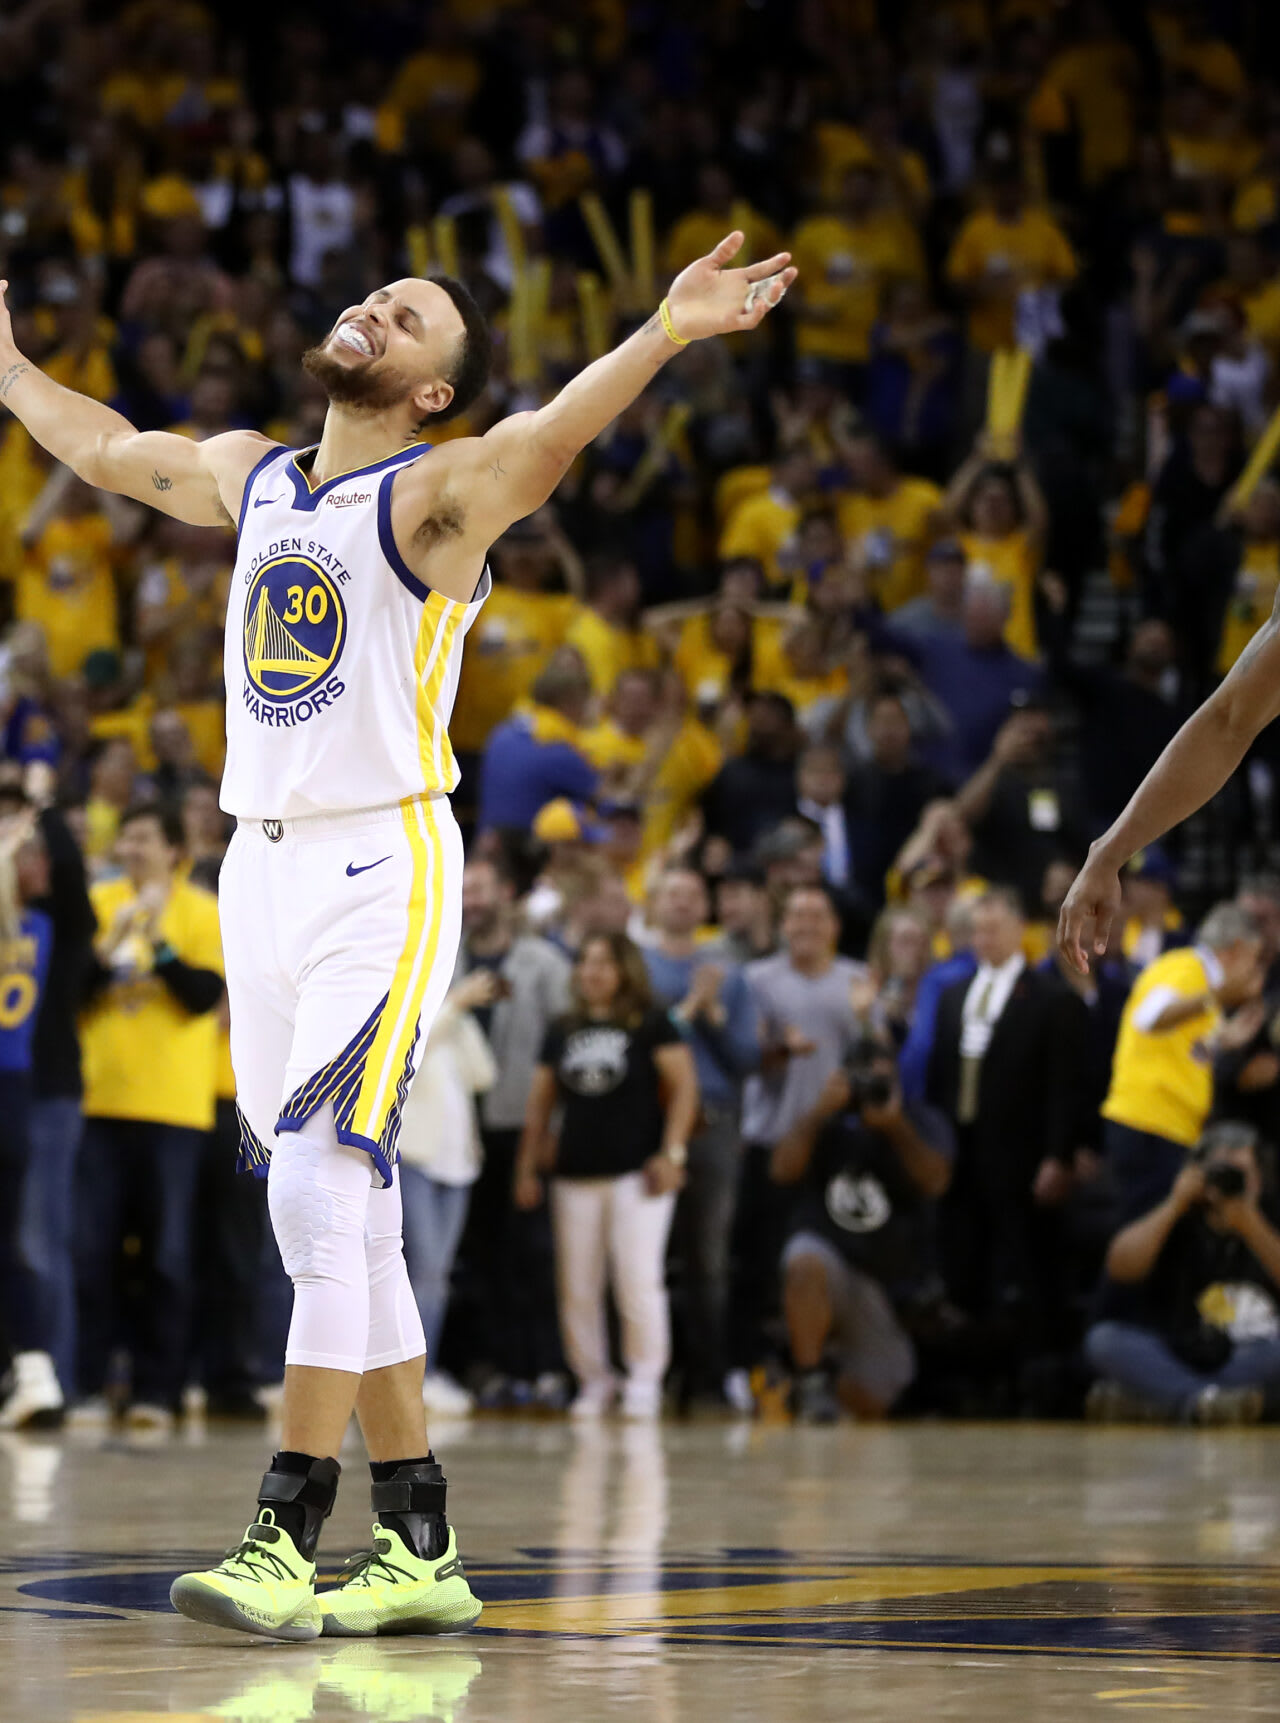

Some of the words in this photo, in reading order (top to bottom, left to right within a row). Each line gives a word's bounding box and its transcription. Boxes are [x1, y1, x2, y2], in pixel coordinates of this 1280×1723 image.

[325, 492, 372, 505] Rakuten
[244, 538, 302, 585] GOLDEN
[307, 541, 352, 586] STATE
[282, 585, 328, 624] 30
[242, 676, 346, 728] WARRIORS
